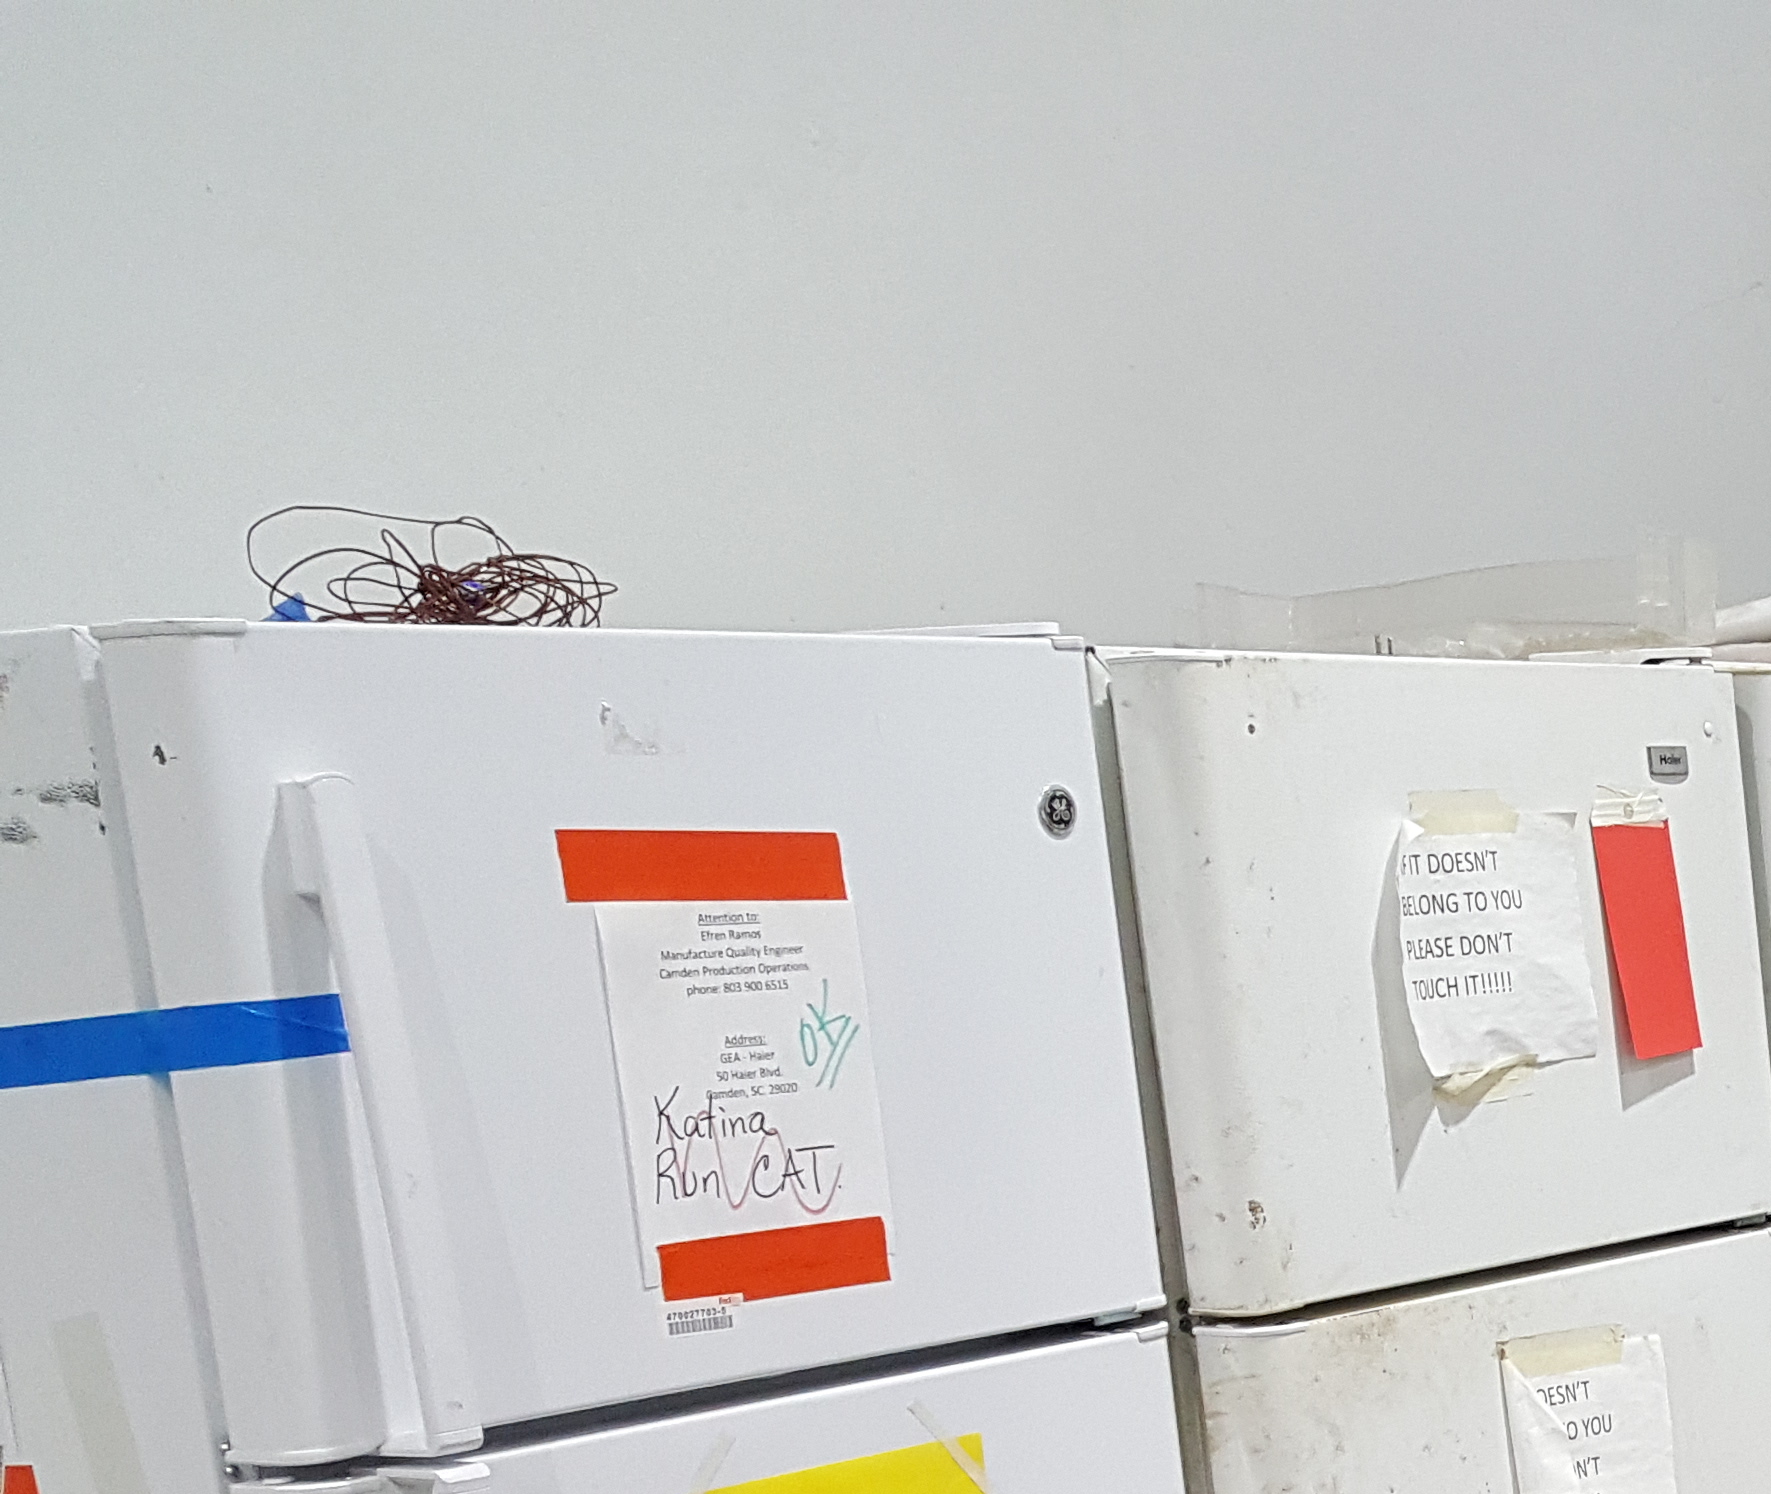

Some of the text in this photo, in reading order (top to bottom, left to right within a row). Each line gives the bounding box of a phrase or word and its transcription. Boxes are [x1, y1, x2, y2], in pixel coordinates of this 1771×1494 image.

[1427, 850, 1497, 874] DOESN'T
[1401, 889, 1522, 916] BELONG TO YOU
[698, 913, 743, 925] Attention
[728, 929, 761, 940] Ramos
[660, 945, 803, 961] Manufacture Quality Engineer
[1406, 931, 1512, 960] PLEASE DON'T
[659, 962, 809, 979] Camden Production Operations
[723, 982, 742, 993] 803
[744, 980, 762, 991] 900
[1412, 976, 1459, 1001] TOUCH
[720, 1052, 741, 1063] GEA
[749, 1051, 775, 1062] Haier
[716, 1071, 728, 1081] 50
[731, 1069, 757, 1080] Haier
[769, 1082, 797, 1095] 29020
[654, 1086, 778, 1144] Katina
[657, 1148, 719, 1204] Run
[1582, 1413, 1612, 1437] YOU
[1573, 1456, 1601, 1479] N'T
